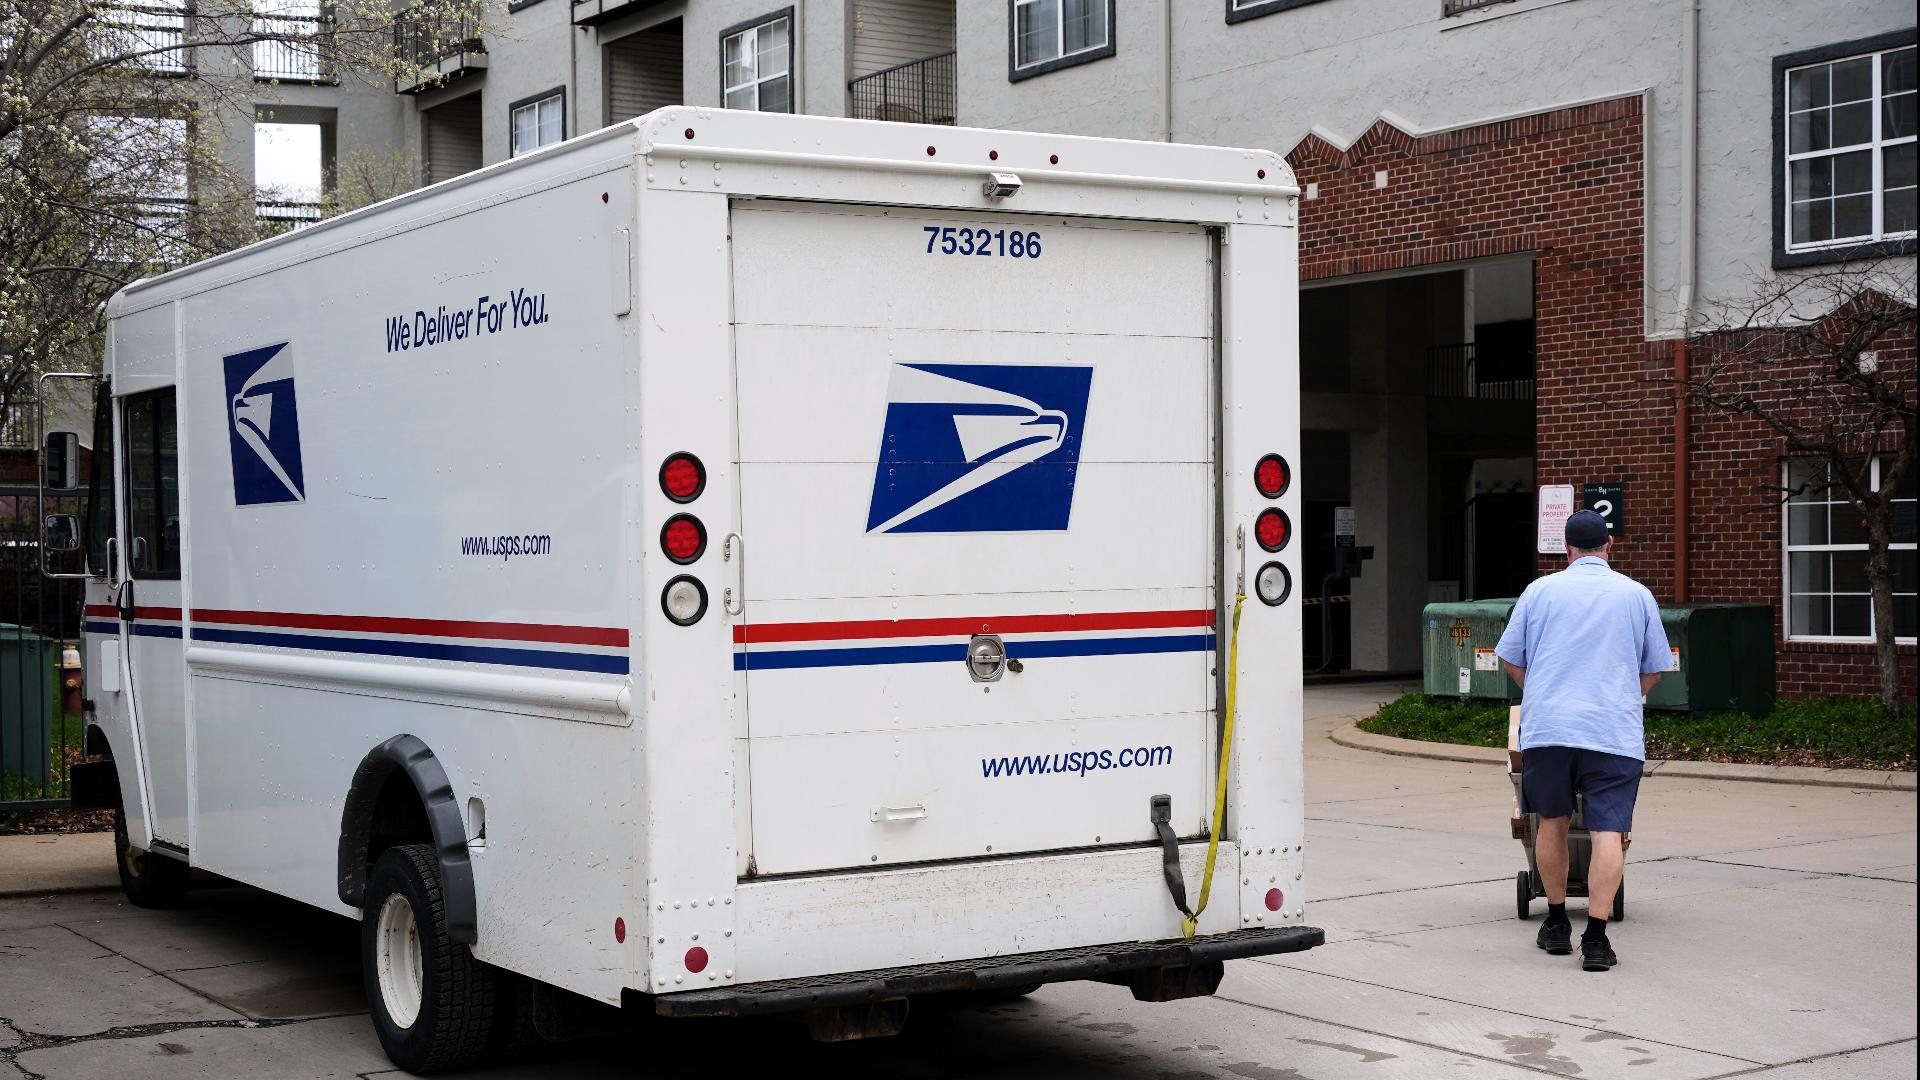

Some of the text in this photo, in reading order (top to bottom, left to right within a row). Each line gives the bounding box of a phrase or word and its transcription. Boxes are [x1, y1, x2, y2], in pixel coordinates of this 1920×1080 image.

[923, 226, 1041, 258] 7532186
[386, 287, 549, 353] We Deliver For You.
[1593, 499, 1613, 528] 2
[461, 534, 551, 561] www.usps.com
[981, 745, 1173, 778] www.usps.com
